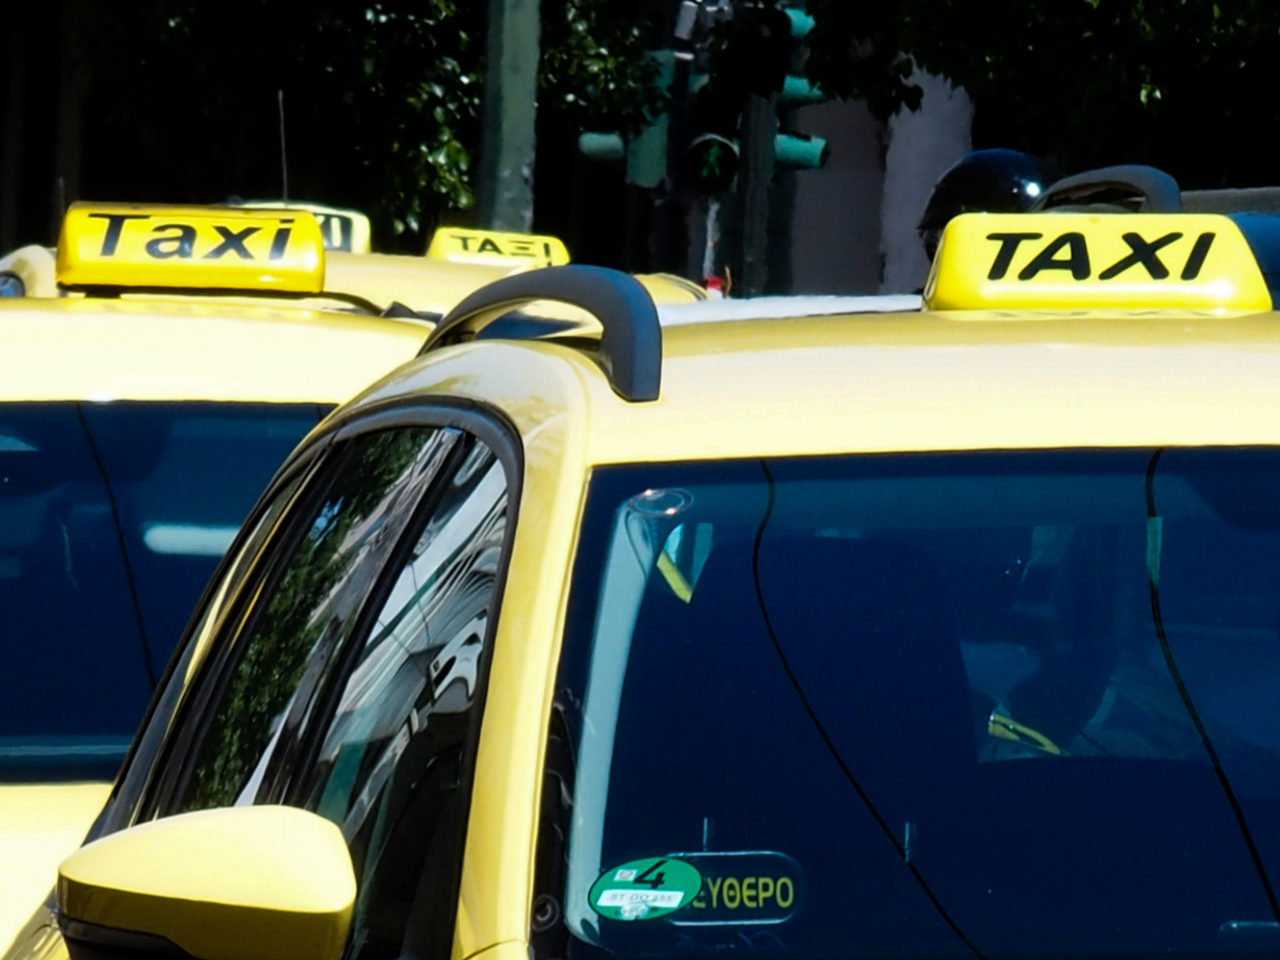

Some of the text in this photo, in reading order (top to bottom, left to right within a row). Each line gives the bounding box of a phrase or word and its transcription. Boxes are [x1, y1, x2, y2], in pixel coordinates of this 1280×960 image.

[88, 213, 295, 260] Taxi
[986, 232, 1216, 281] TAXI
[632, 859, 668, 889] 4
